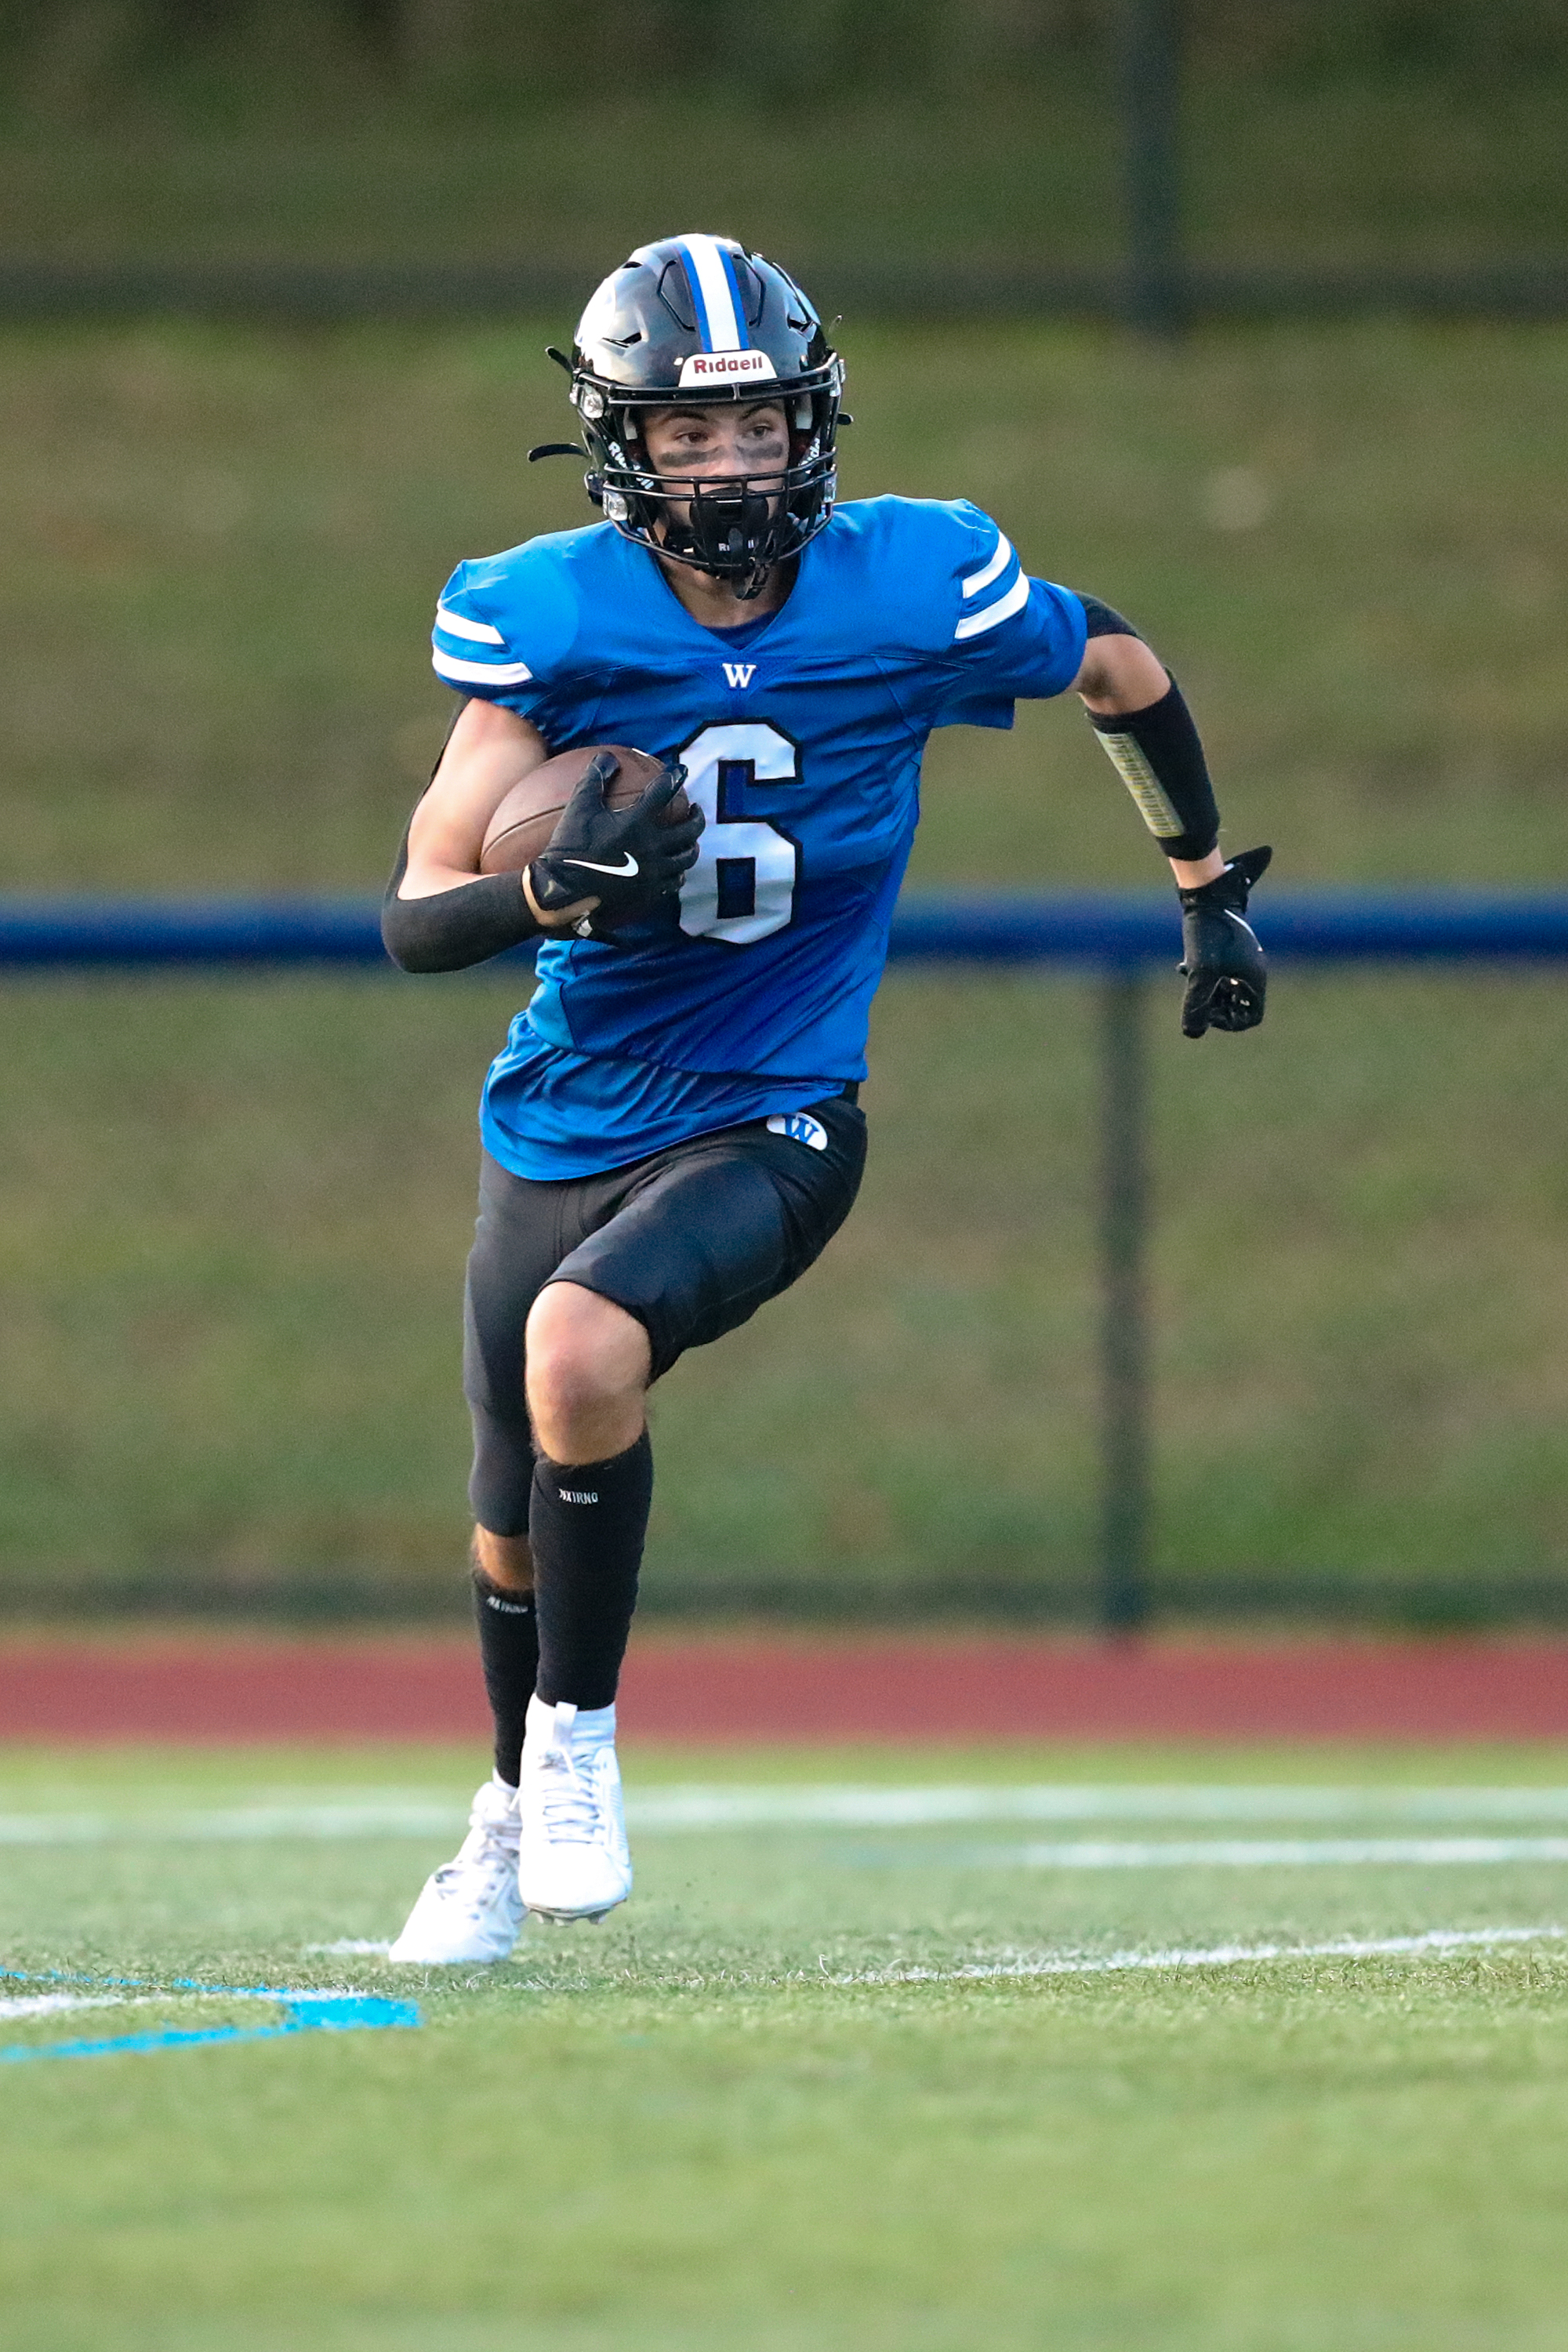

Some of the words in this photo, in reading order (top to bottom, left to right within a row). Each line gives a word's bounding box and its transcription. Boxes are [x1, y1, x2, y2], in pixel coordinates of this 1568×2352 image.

[693, 356, 763, 374] Riddell
[608, 441, 655, 490] Rill
[718, 539, 754, 552] Rill
[722, 662, 757, 688] W
[677, 717, 801, 946] 6
[782, 1113, 818, 1144] W
